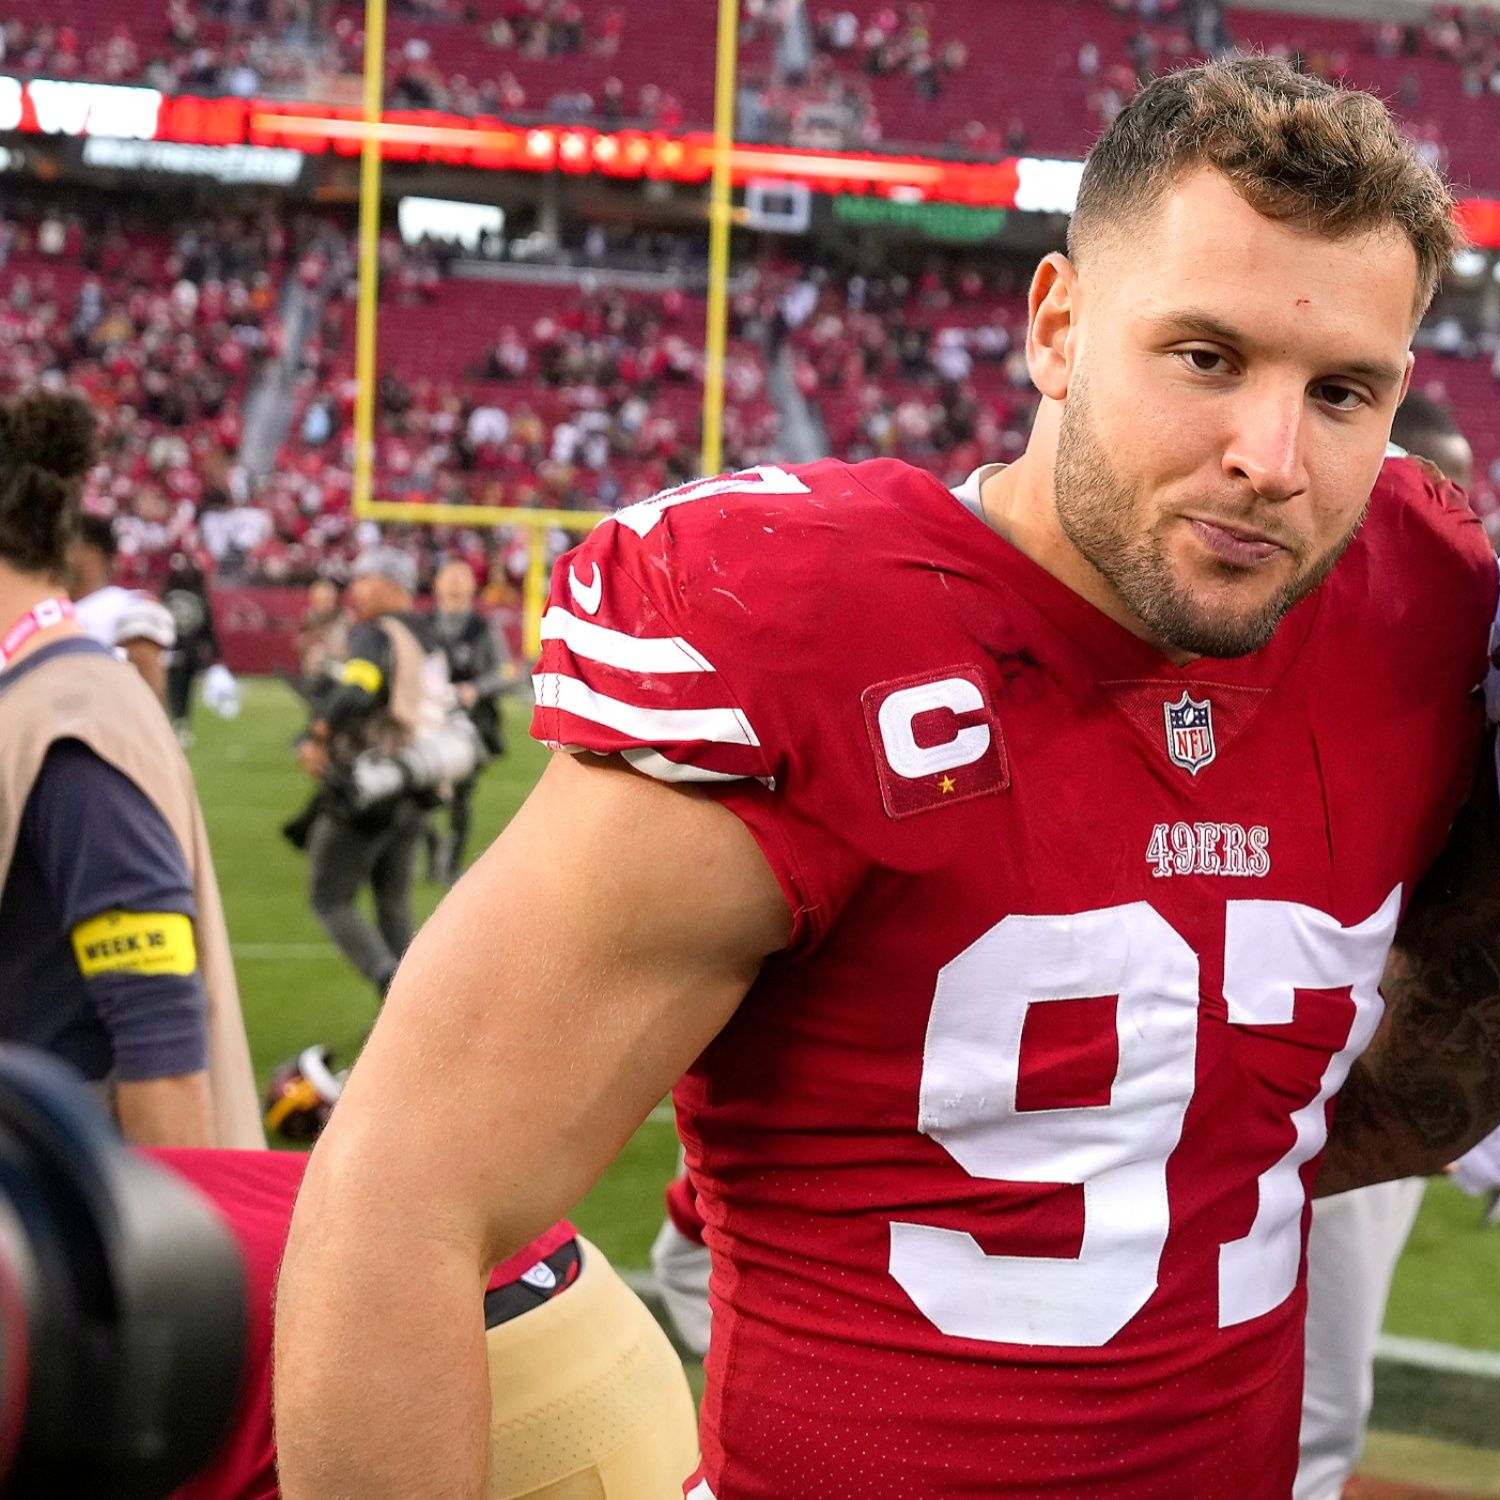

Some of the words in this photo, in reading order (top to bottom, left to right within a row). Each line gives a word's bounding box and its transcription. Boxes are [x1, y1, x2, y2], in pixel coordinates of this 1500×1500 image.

[878, 679, 992, 779] C
[1175, 729, 1210, 760] NFL
[1146, 821, 1271, 878] 49ERS
[84, 936, 141, 960] WEEK
[888, 883, 1403, 1347] 97
